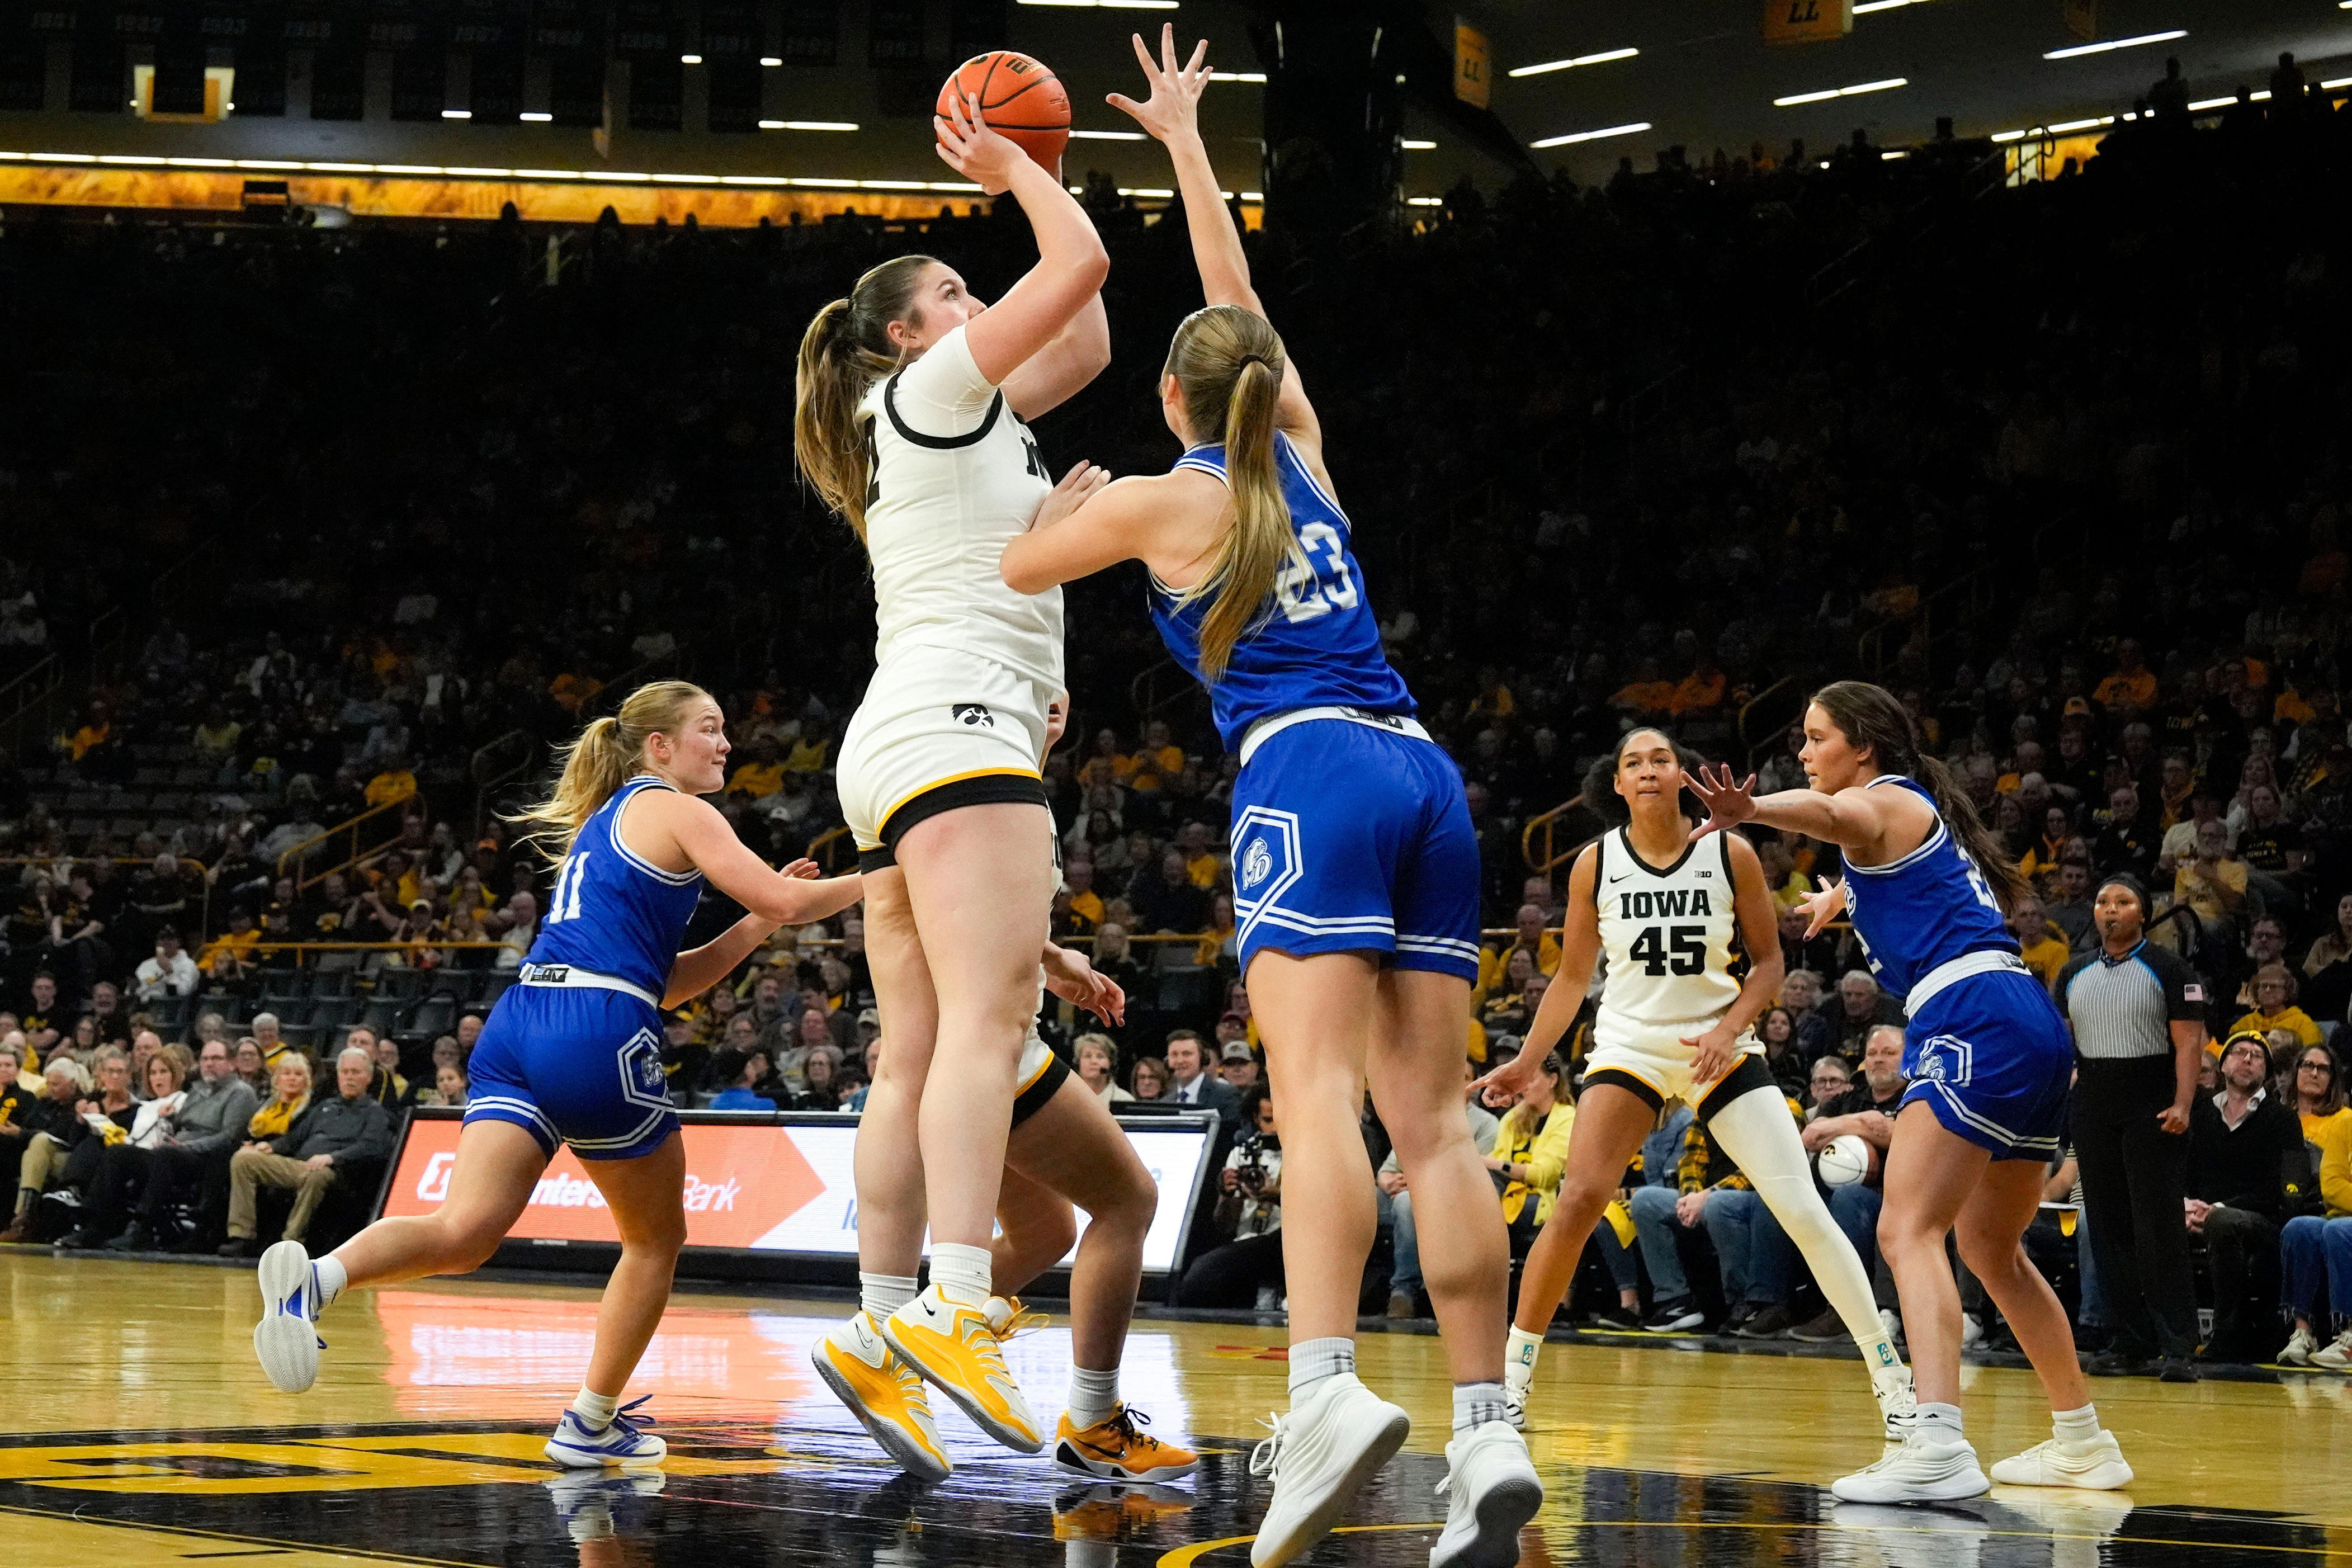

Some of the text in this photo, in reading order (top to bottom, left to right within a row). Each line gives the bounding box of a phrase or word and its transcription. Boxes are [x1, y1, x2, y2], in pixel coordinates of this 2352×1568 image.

[1274, 521, 1358, 624] 23
[549, 851, 591, 924] 11
[1621, 889, 1712, 919] IOWA
[1630, 925, 1707, 976] 45
[683, 1174, 741, 1211] Bank
